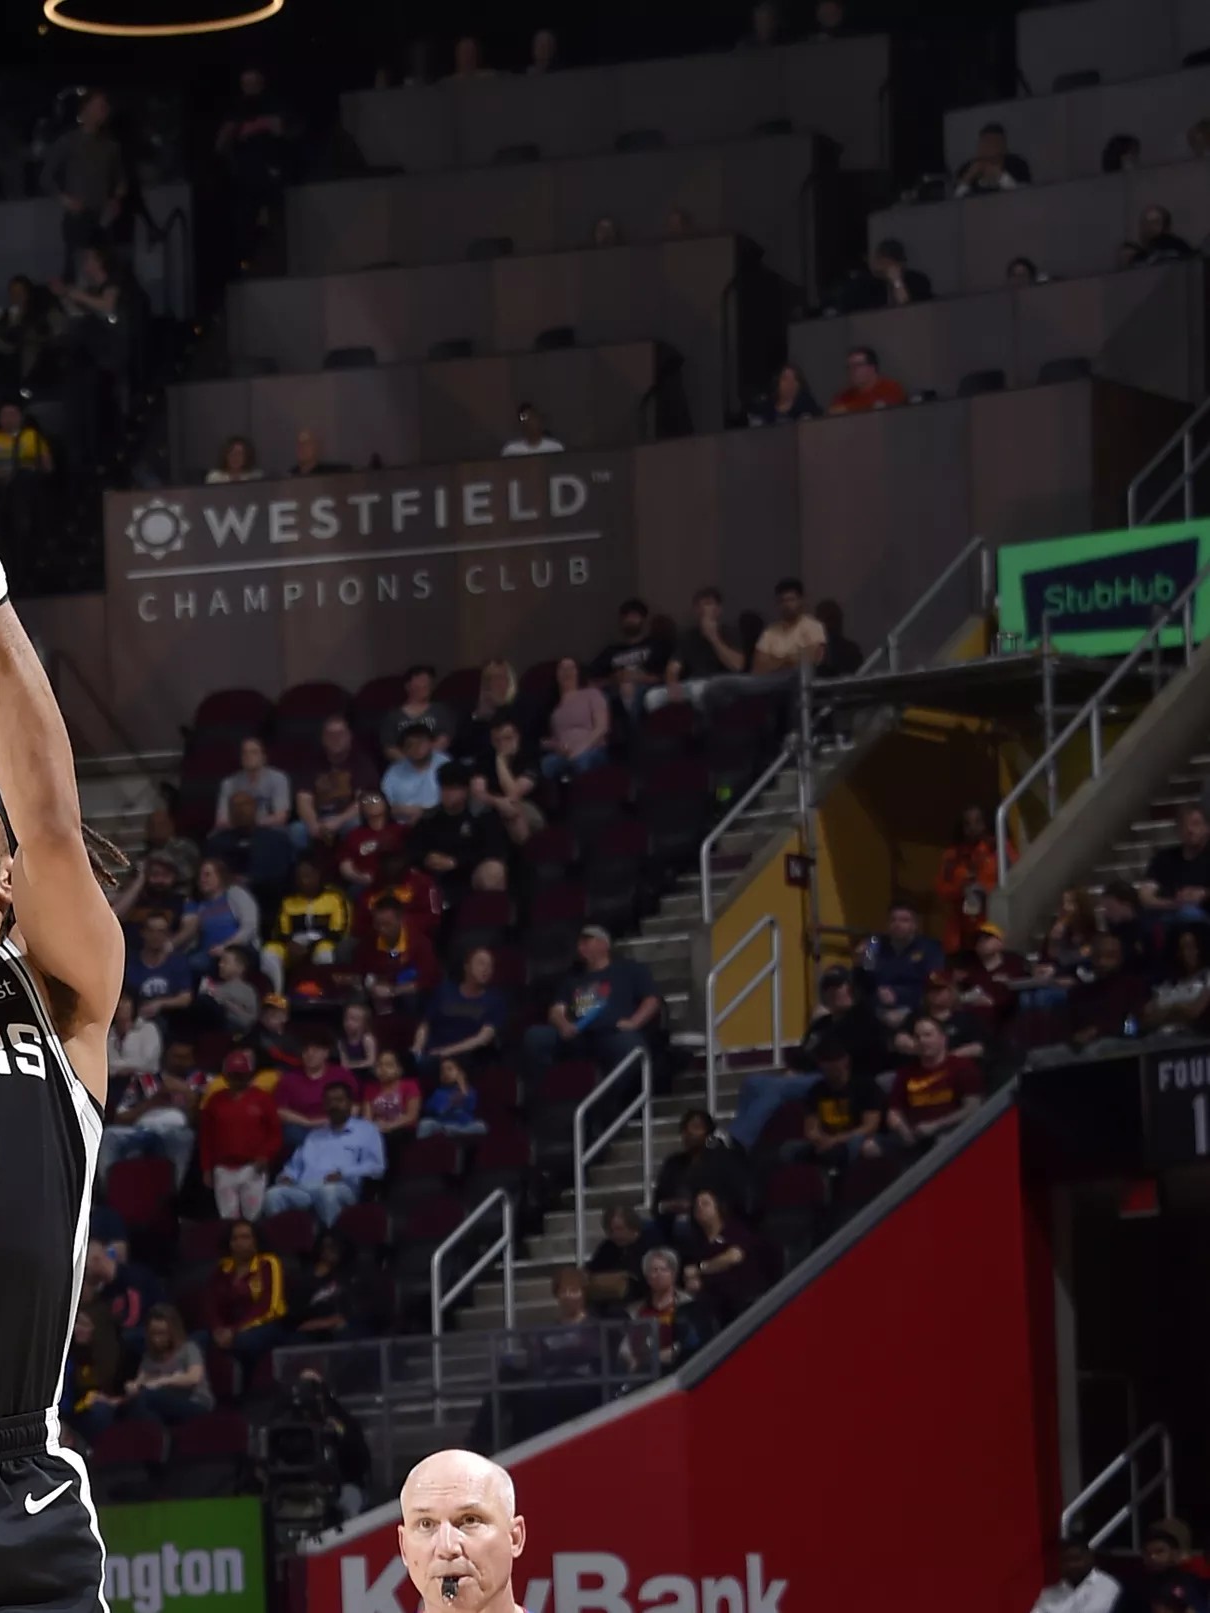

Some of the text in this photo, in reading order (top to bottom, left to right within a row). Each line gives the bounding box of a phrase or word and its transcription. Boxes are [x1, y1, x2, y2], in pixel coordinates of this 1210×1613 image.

[203, 473, 586, 549] WESTFIELD
[137, 556, 590, 623] CHAMPIONS CLUB
[1044, 571, 1177, 618] StubHub
[1157, 1057, 1210, 1091] FOU
[341, 1552, 788, 1613] KBank
